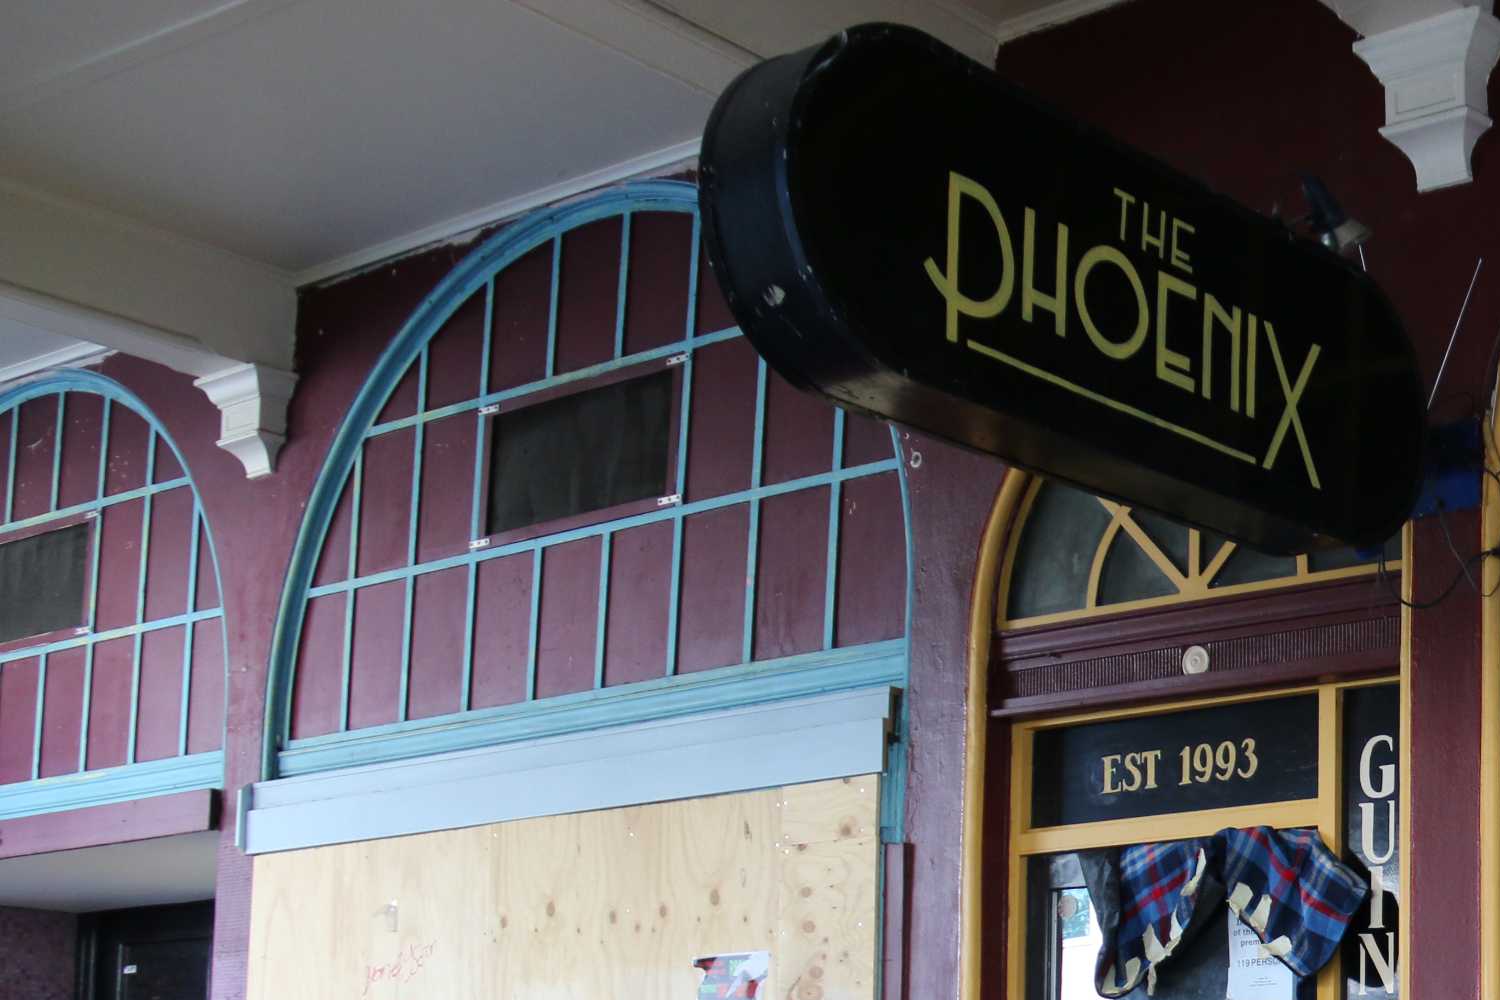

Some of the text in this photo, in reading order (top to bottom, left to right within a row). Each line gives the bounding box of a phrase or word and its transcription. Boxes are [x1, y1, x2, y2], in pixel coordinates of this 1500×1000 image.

[1113, 188, 1195, 274] THE
[923, 171, 1321, 489] PHOENIX
[1101, 738, 1258, 794] EST 1993
